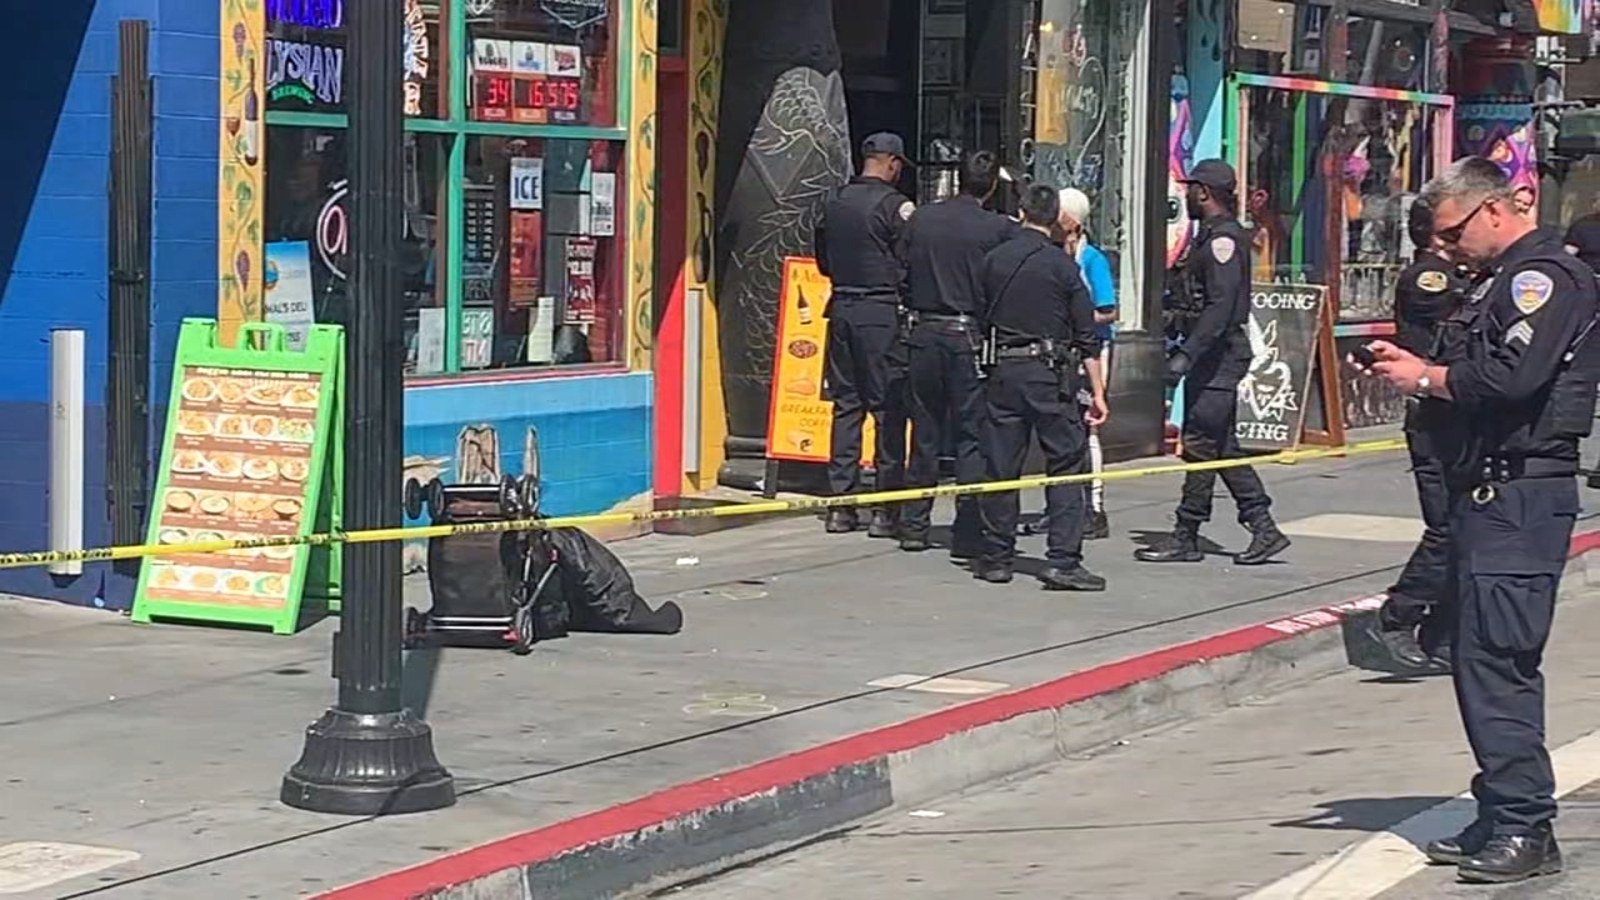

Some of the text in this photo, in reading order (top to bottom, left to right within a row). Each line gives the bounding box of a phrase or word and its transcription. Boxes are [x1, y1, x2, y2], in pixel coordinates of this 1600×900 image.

[265, 40, 343, 103] LYSIAN
[488, 78, 509, 105] 34
[514, 175, 540, 201] ICE
[1250, 292, 1317, 310] OOING
